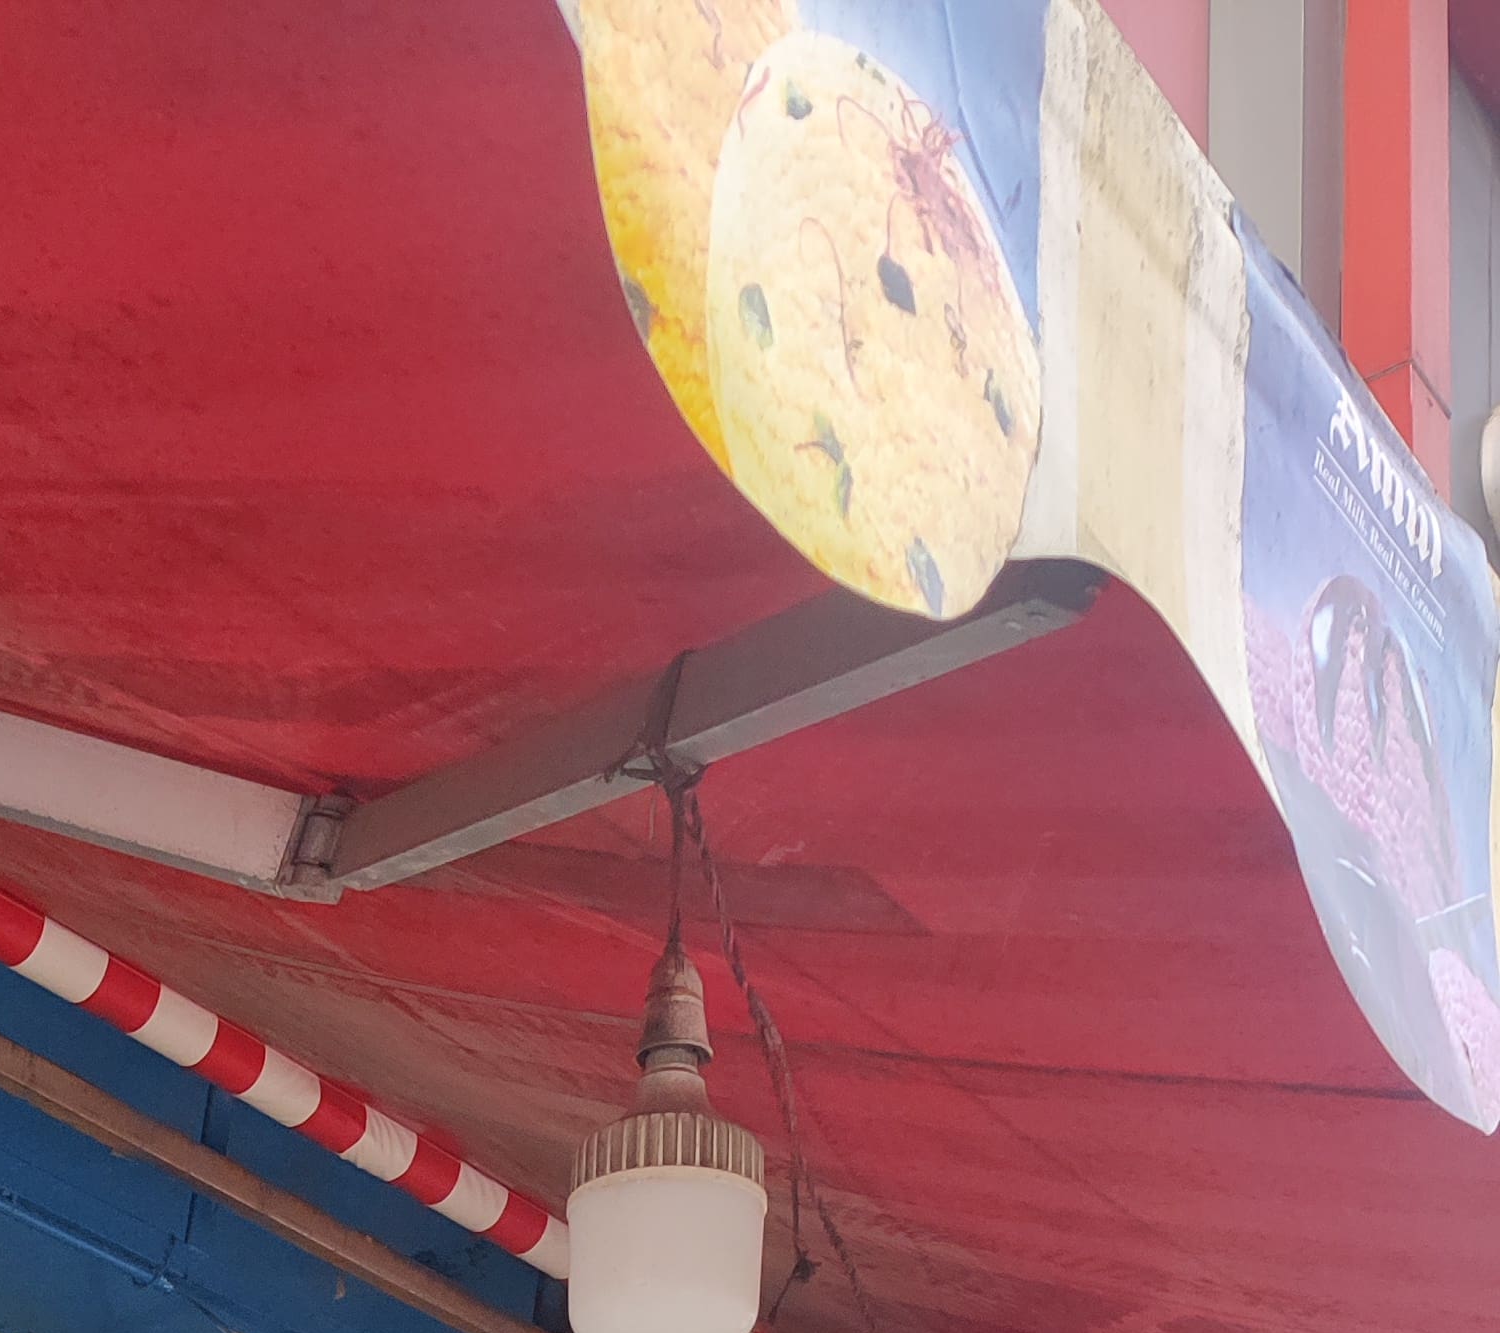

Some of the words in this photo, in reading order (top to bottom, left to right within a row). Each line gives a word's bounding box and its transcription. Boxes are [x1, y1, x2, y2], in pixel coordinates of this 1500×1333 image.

[1313, 450, 1341, 497] Real
[1369, 526, 1394, 571] Real
[1329, 388, 1443, 581] Amul
